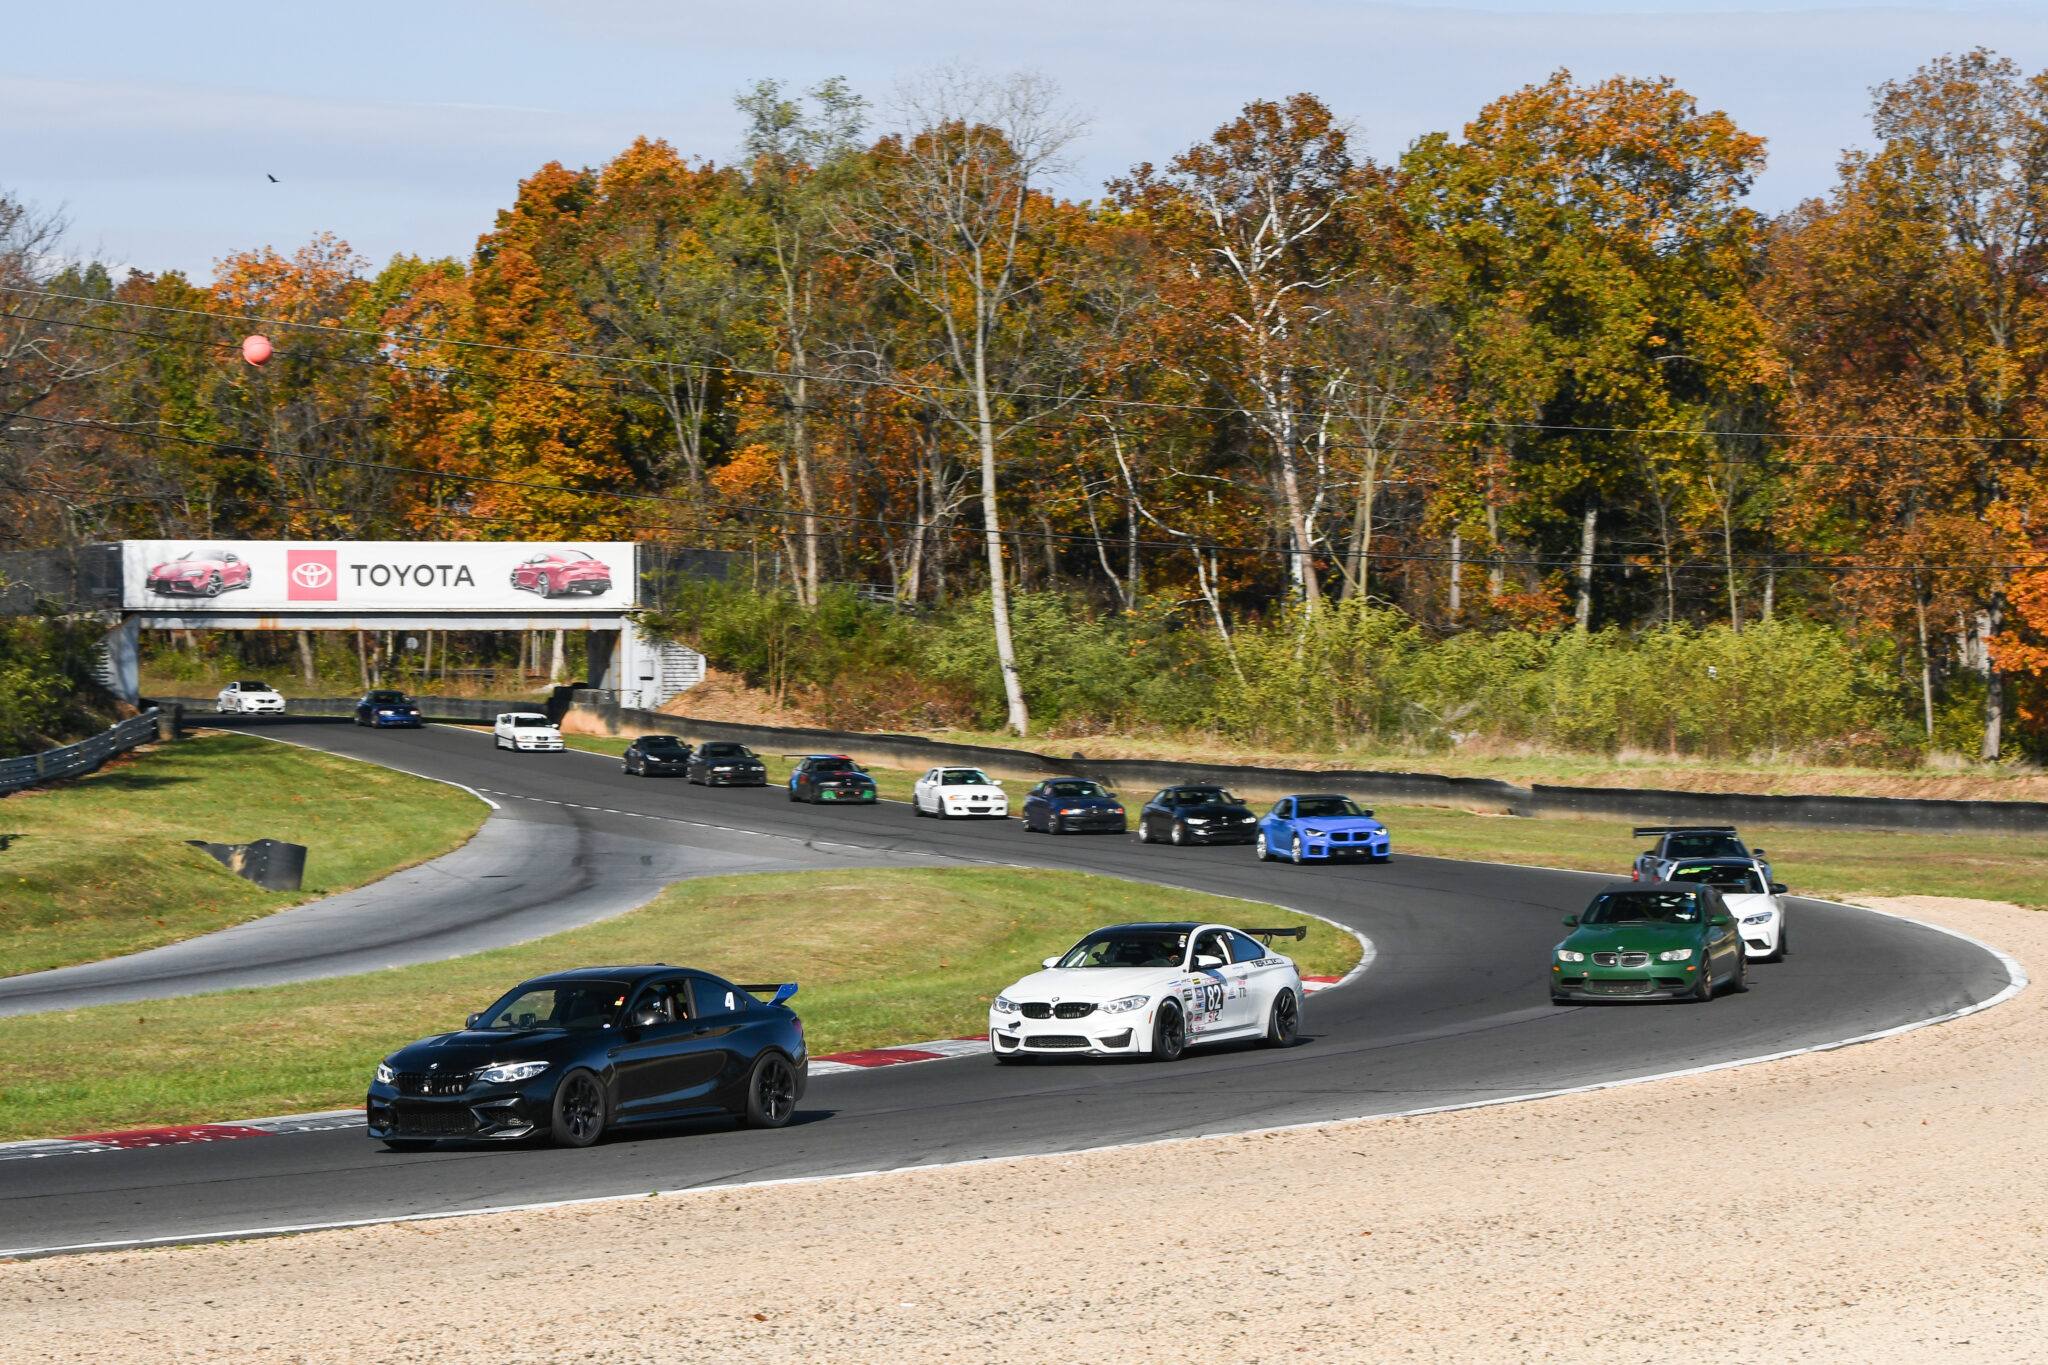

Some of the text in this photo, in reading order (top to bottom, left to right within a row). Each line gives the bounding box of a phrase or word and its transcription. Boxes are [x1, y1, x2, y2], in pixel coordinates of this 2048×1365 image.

[350, 564, 475, 587] TOYOTA
[724, 991, 735, 1011] 4
[1207, 984, 1221, 1011] 82
